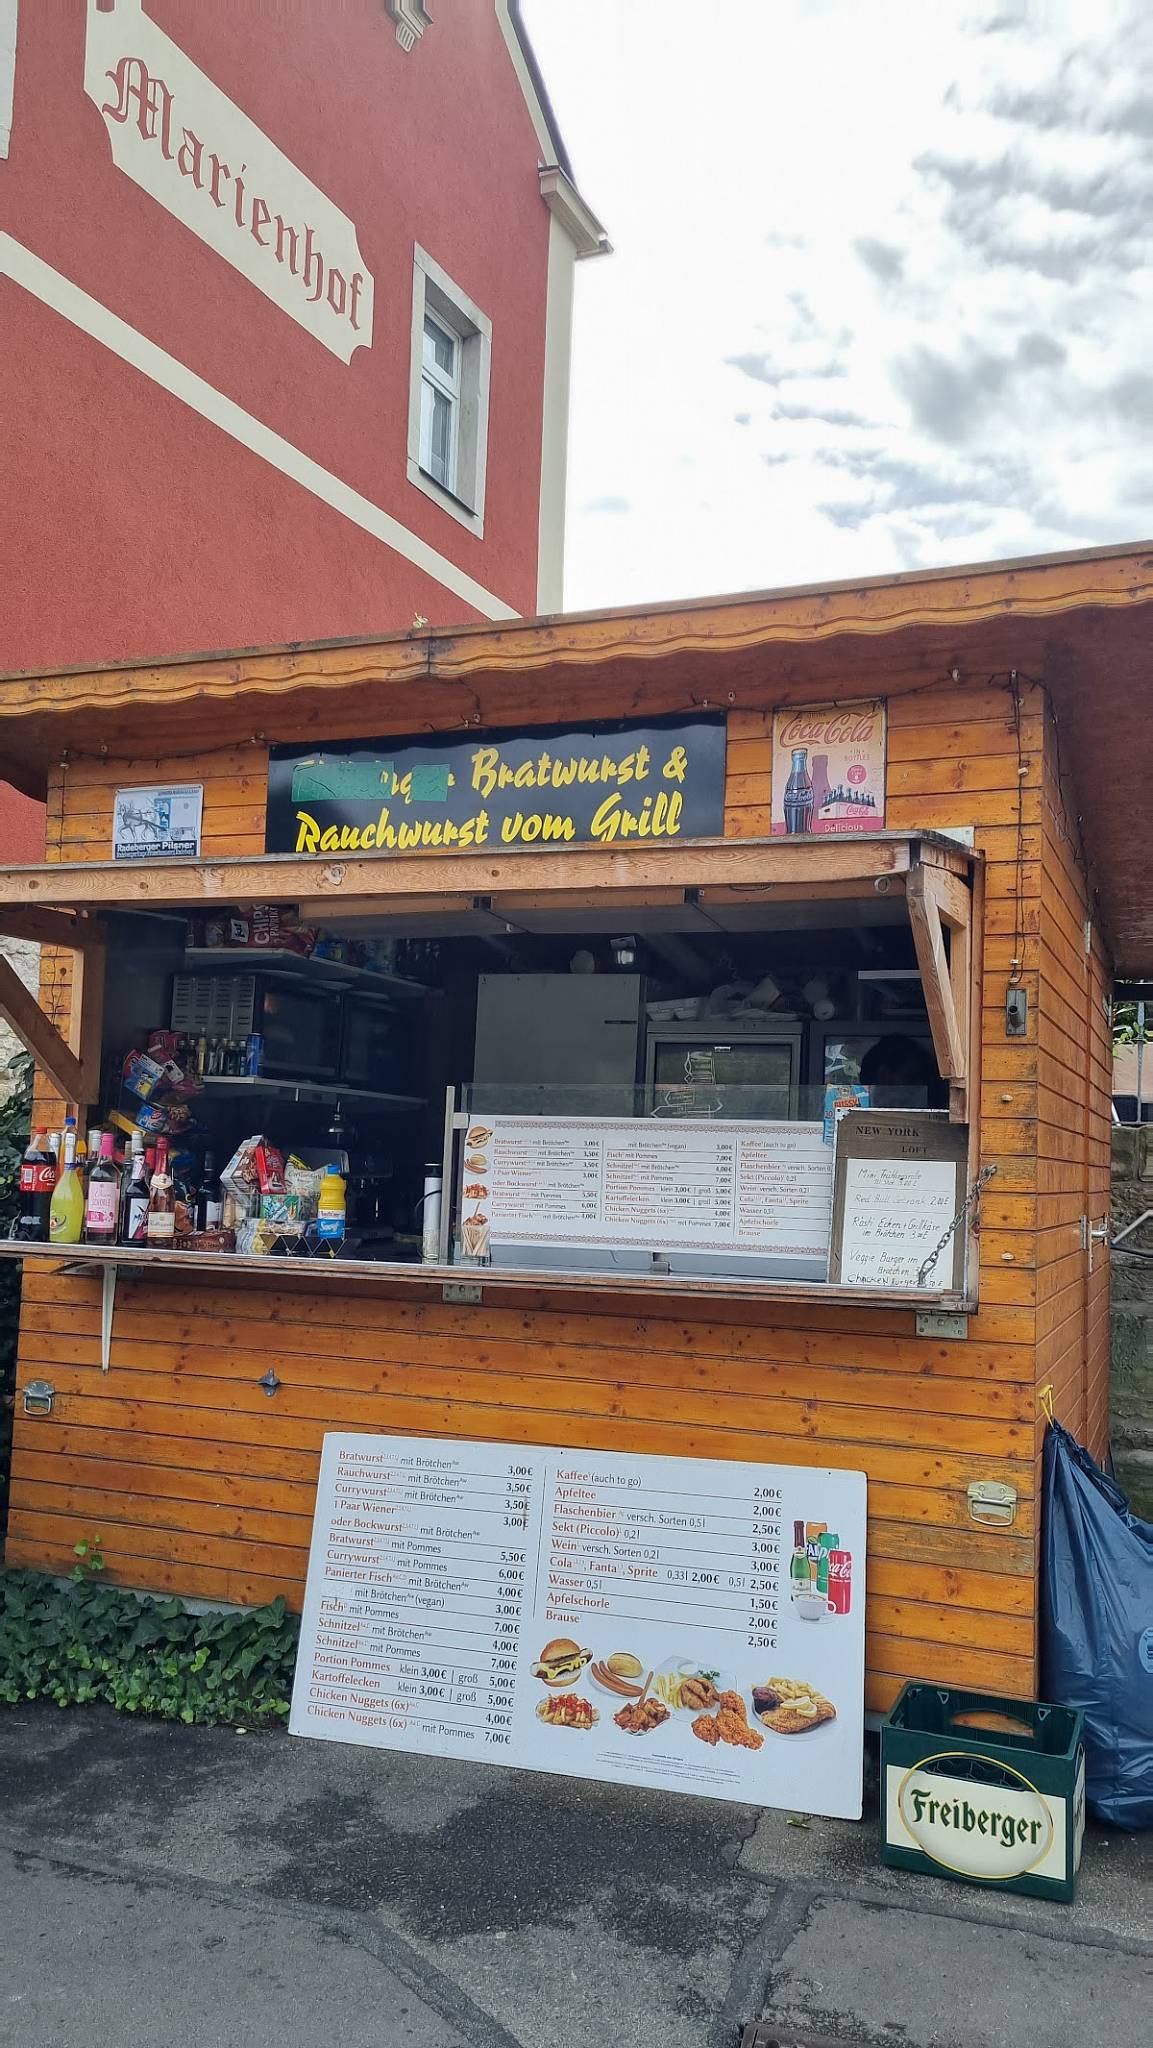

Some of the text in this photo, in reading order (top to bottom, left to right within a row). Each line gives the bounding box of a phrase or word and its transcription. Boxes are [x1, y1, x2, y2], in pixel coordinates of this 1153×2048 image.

[102, 57, 364, 331] Marienhof
[472, 745, 650, 799] Bratwurst
[662, 746, 688, 783] &
[295, 790, 683, 852] Rauchwurst vom Grill
[162, 841, 194, 849] Pilsner
[856, 1126, 920, 1137] NEW YORK
[901, 1145, 928, 1154] LOFT
[339, 1451, 533, 1476] Bratwurst mit Brötchen 3,00€
[337, 1467, 531, 1493] Rauchwurst mit Brötchen 3,50€
[557, 1469, 782, 1499] Kaffee (auch to go) 2,00€
[335, 1484, 530, 1510] Currywurst mit Brötchen 3,50€
[555, 1487, 782, 1517] Apfeltee 2,00€
[331, 1517, 472, 1540] oder Bockwurst mit Brötchen
[340, 1501, 360, 1511] Paar
[363, 1503, 396, 1514] Wiener
[503, 1517, 528, 1528] 3,00€
[554, 1504, 616, 1519] Flaschenbier
[626, 1512, 656, 1523] versch.
[659, 1514, 687, 1526] Sorten
[752, 1524, 781, 1536] 2,50€
[329, 1533, 526, 1562] Bratwurst mit Pommes 5,50€
[552, 1522, 574, 1533] Sekt
[576, 1524, 619, 1538] (Piccolo)
[752, 1542, 780, 1554] 3,00€
[327, 1550, 524, 1581] Currywurst mit Pommes 6,00€
[551, 1539, 577, 1551] Wein
[582, 1543, 611, 1554] versch.
[614, 1545, 642, 1557] Sorten
[751, 1561, 780, 1573] 3,00€
[325, 1567, 523, 1598] Panierter Fisch mit Brötchen 4,00€
[548, 1574, 584, 1588] Wasser
[750, 1598, 778, 1610] 1,50€
[627, 1565, 658, 1578] Sprite
[691, 1572, 720, 1584] 2,00€
[750, 1579, 779, 1592] 2,50€
[320, 1600, 520, 1634] Fisch mit Pommes 7,00€
[355, 1588, 521, 1616] mit Brötchen (vegan) 3,00€
[546, 1593, 778, 1629] Apfelschorle 2,00€
[318, 1617, 518, 1652] Schnitzel mit Brötchen 4,00€
[546, 1610, 777, 1648] Brause 2,50€
[316, 1635, 517, 1670] Schnitzel mit Pommes 7,00€
[314, 1652, 515, 1689] Portion Pommes klein 3,00€ groß 5,00€
[312, 1670, 514, 1707] Kartoffelecken klein 3,00€ groß 5,00€
[309, 1688, 512, 1726] Chicken Nuggets (6x) 4,00€
[307, 1705, 511, 1744] Chicken Nuggets (6x) mit Pommes 7,00€
[911, 1788, 1042, 1848] Freiberger
